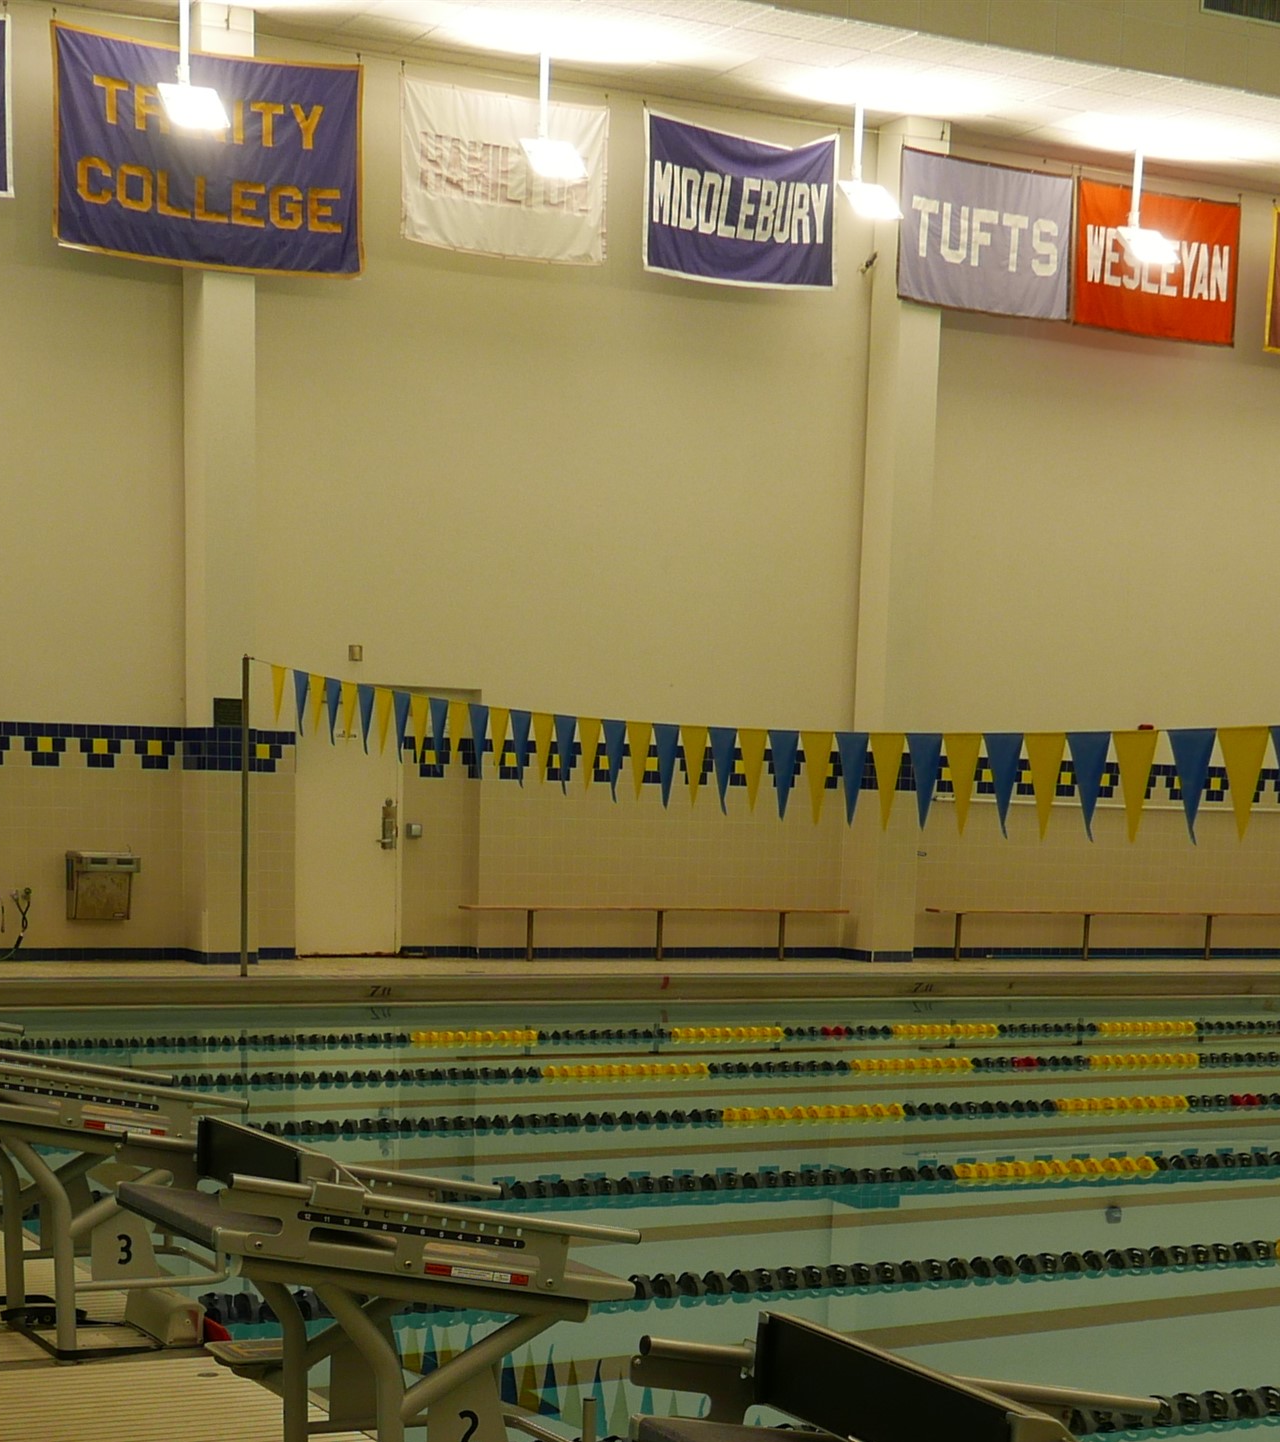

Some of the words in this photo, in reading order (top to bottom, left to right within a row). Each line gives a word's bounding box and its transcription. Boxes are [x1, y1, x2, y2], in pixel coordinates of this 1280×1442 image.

[93, 74, 324, 150] TRITY
[77, 156, 342, 233] COLLEGE
[653, 160, 828, 244] MIDDLEBURY
[912, 195, 1059, 277] TUFTS
[1086, 224, 1230, 303] WESLEYAN
[117, 1233, 132, 1265] 3
